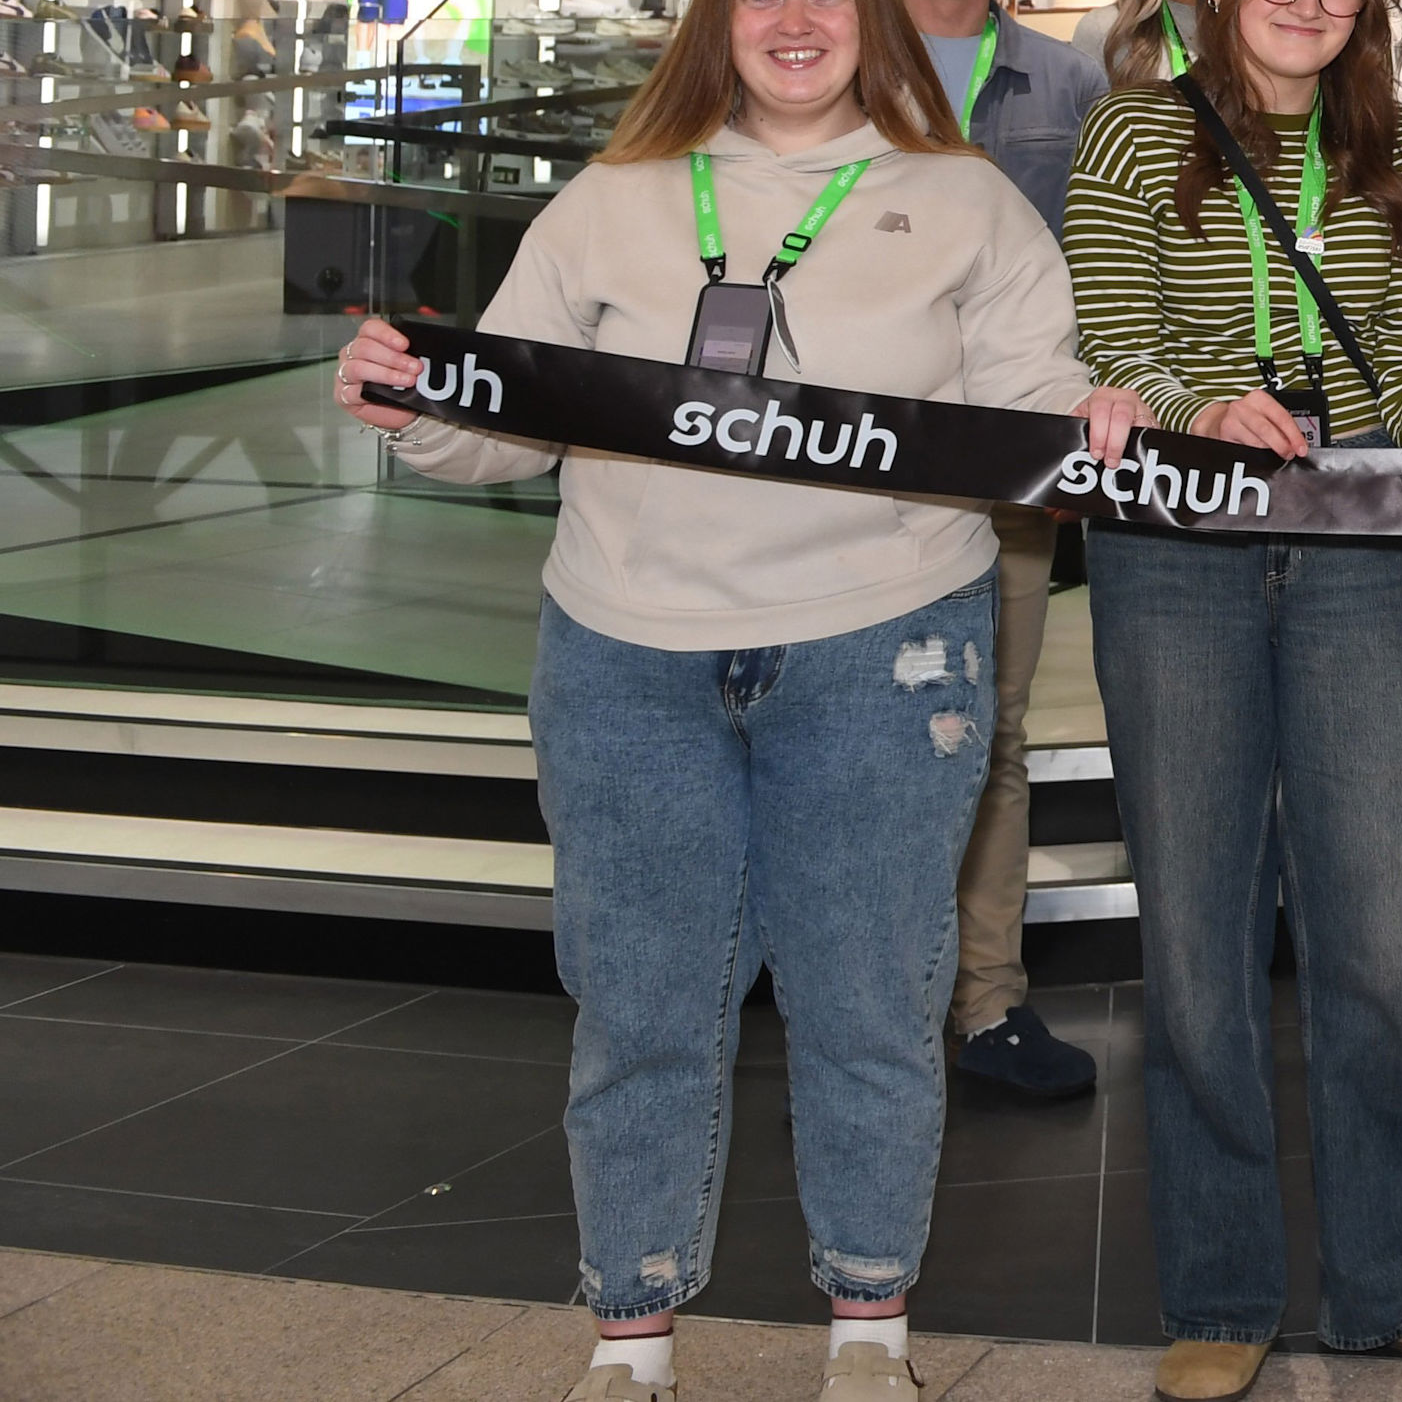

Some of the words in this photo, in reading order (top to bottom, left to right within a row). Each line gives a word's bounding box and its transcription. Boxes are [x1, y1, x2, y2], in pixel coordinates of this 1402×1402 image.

[805, 205, 827, 231] schuh
[413, 353, 503, 413] uh
[667, 399, 898, 472] schuh
[1055, 448, 1270, 517] schuh
